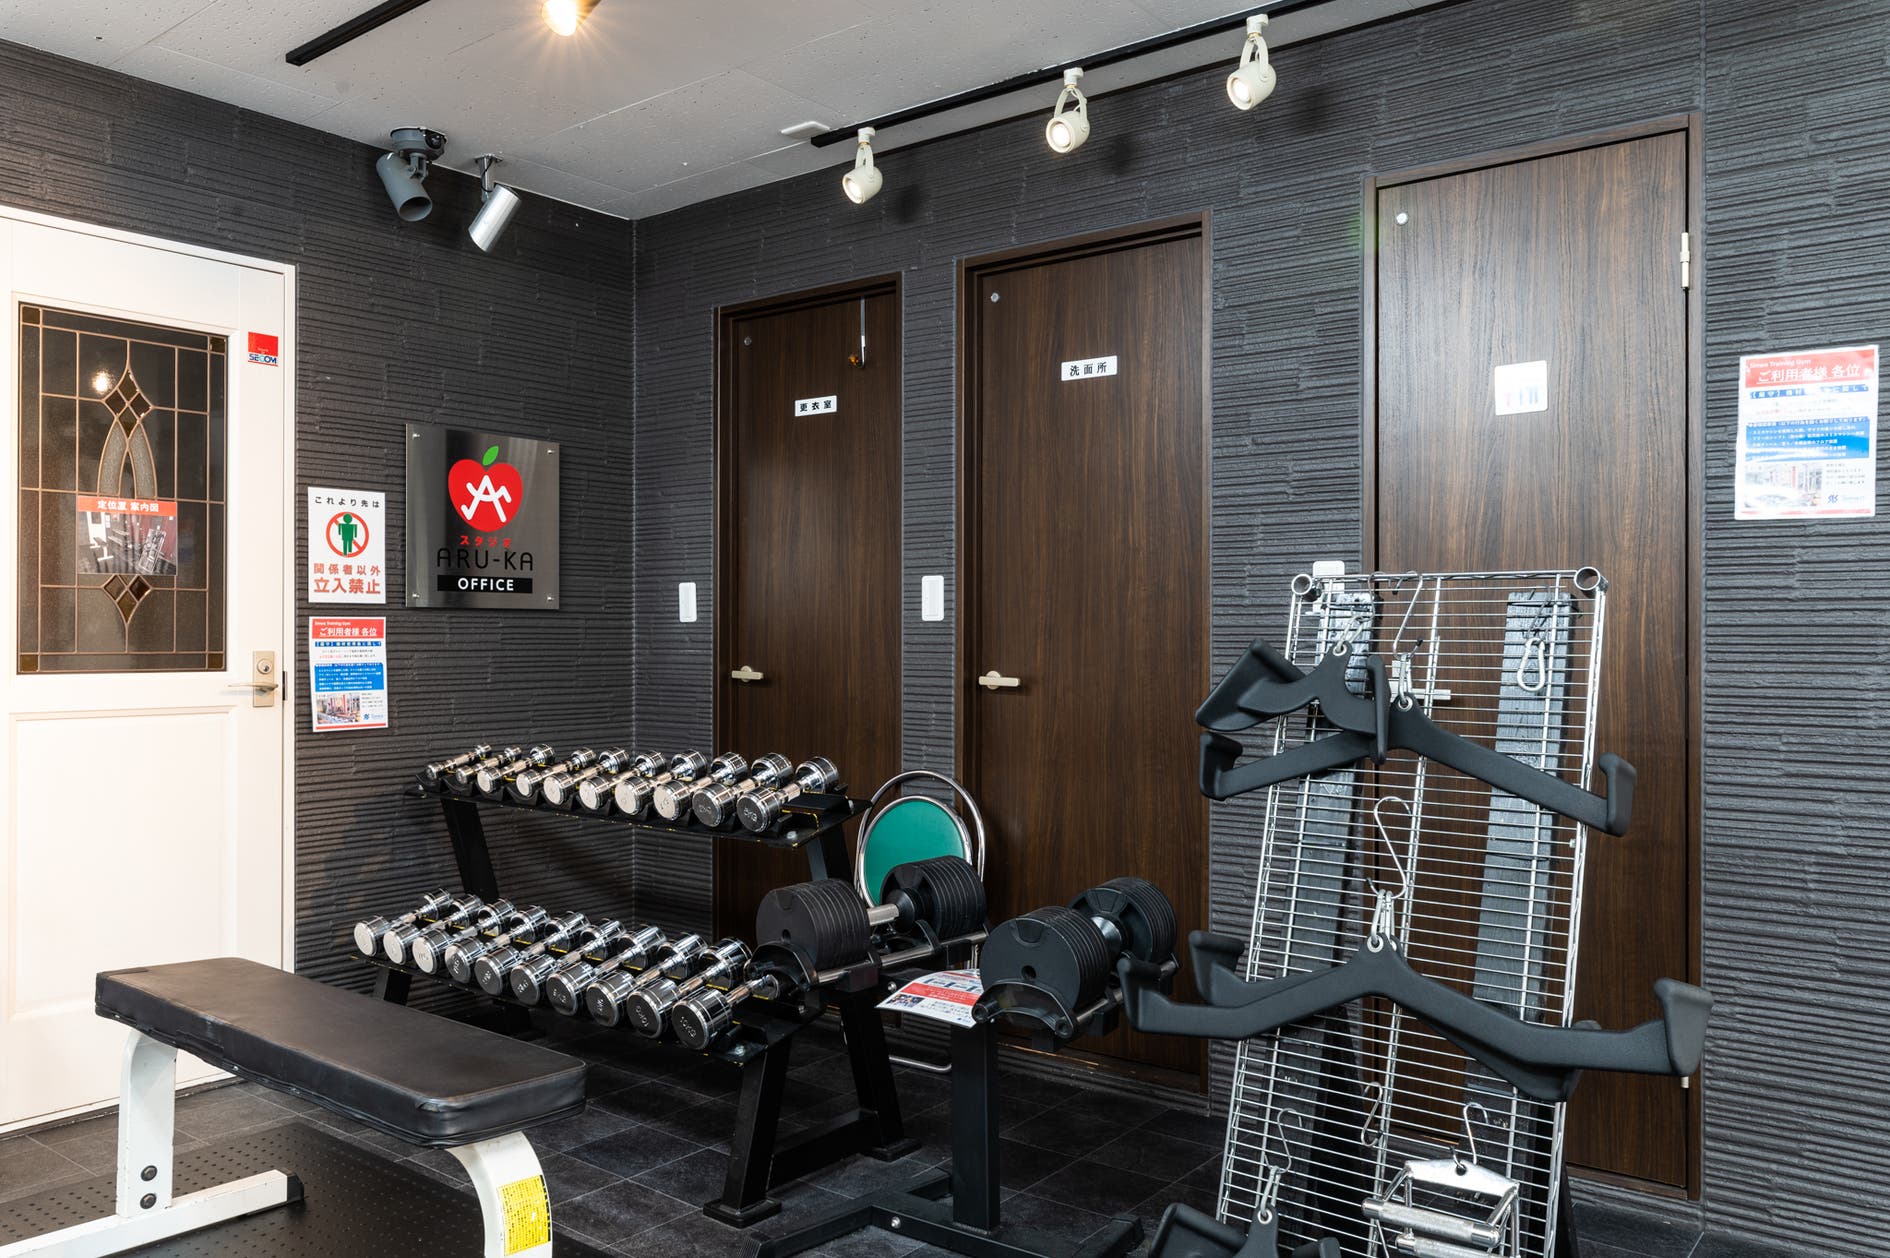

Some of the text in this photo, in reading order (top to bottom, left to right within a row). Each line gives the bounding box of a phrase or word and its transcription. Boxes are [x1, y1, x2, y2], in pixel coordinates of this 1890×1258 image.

[249, 353, 277, 364] SECOM
[1070, 361, 1107, 376] 洗面所
[1758, 365, 1828, 382] ご利用者様
[1831, 363, 1861, 378] 各位
[800, 400, 832, 412] 更衣室
[314, 496, 380, 508] これより先は
[460, 535, 512, 548] スタジオ
[437, 548, 533, 571] ARU-KA
[313, 563, 381, 577] 関係者以外
[313, 577, 381, 595] 立入禁止
[457, 577, 515, 591] OFFICE
[319, 627, 377, 637] ご利用者様 各位
